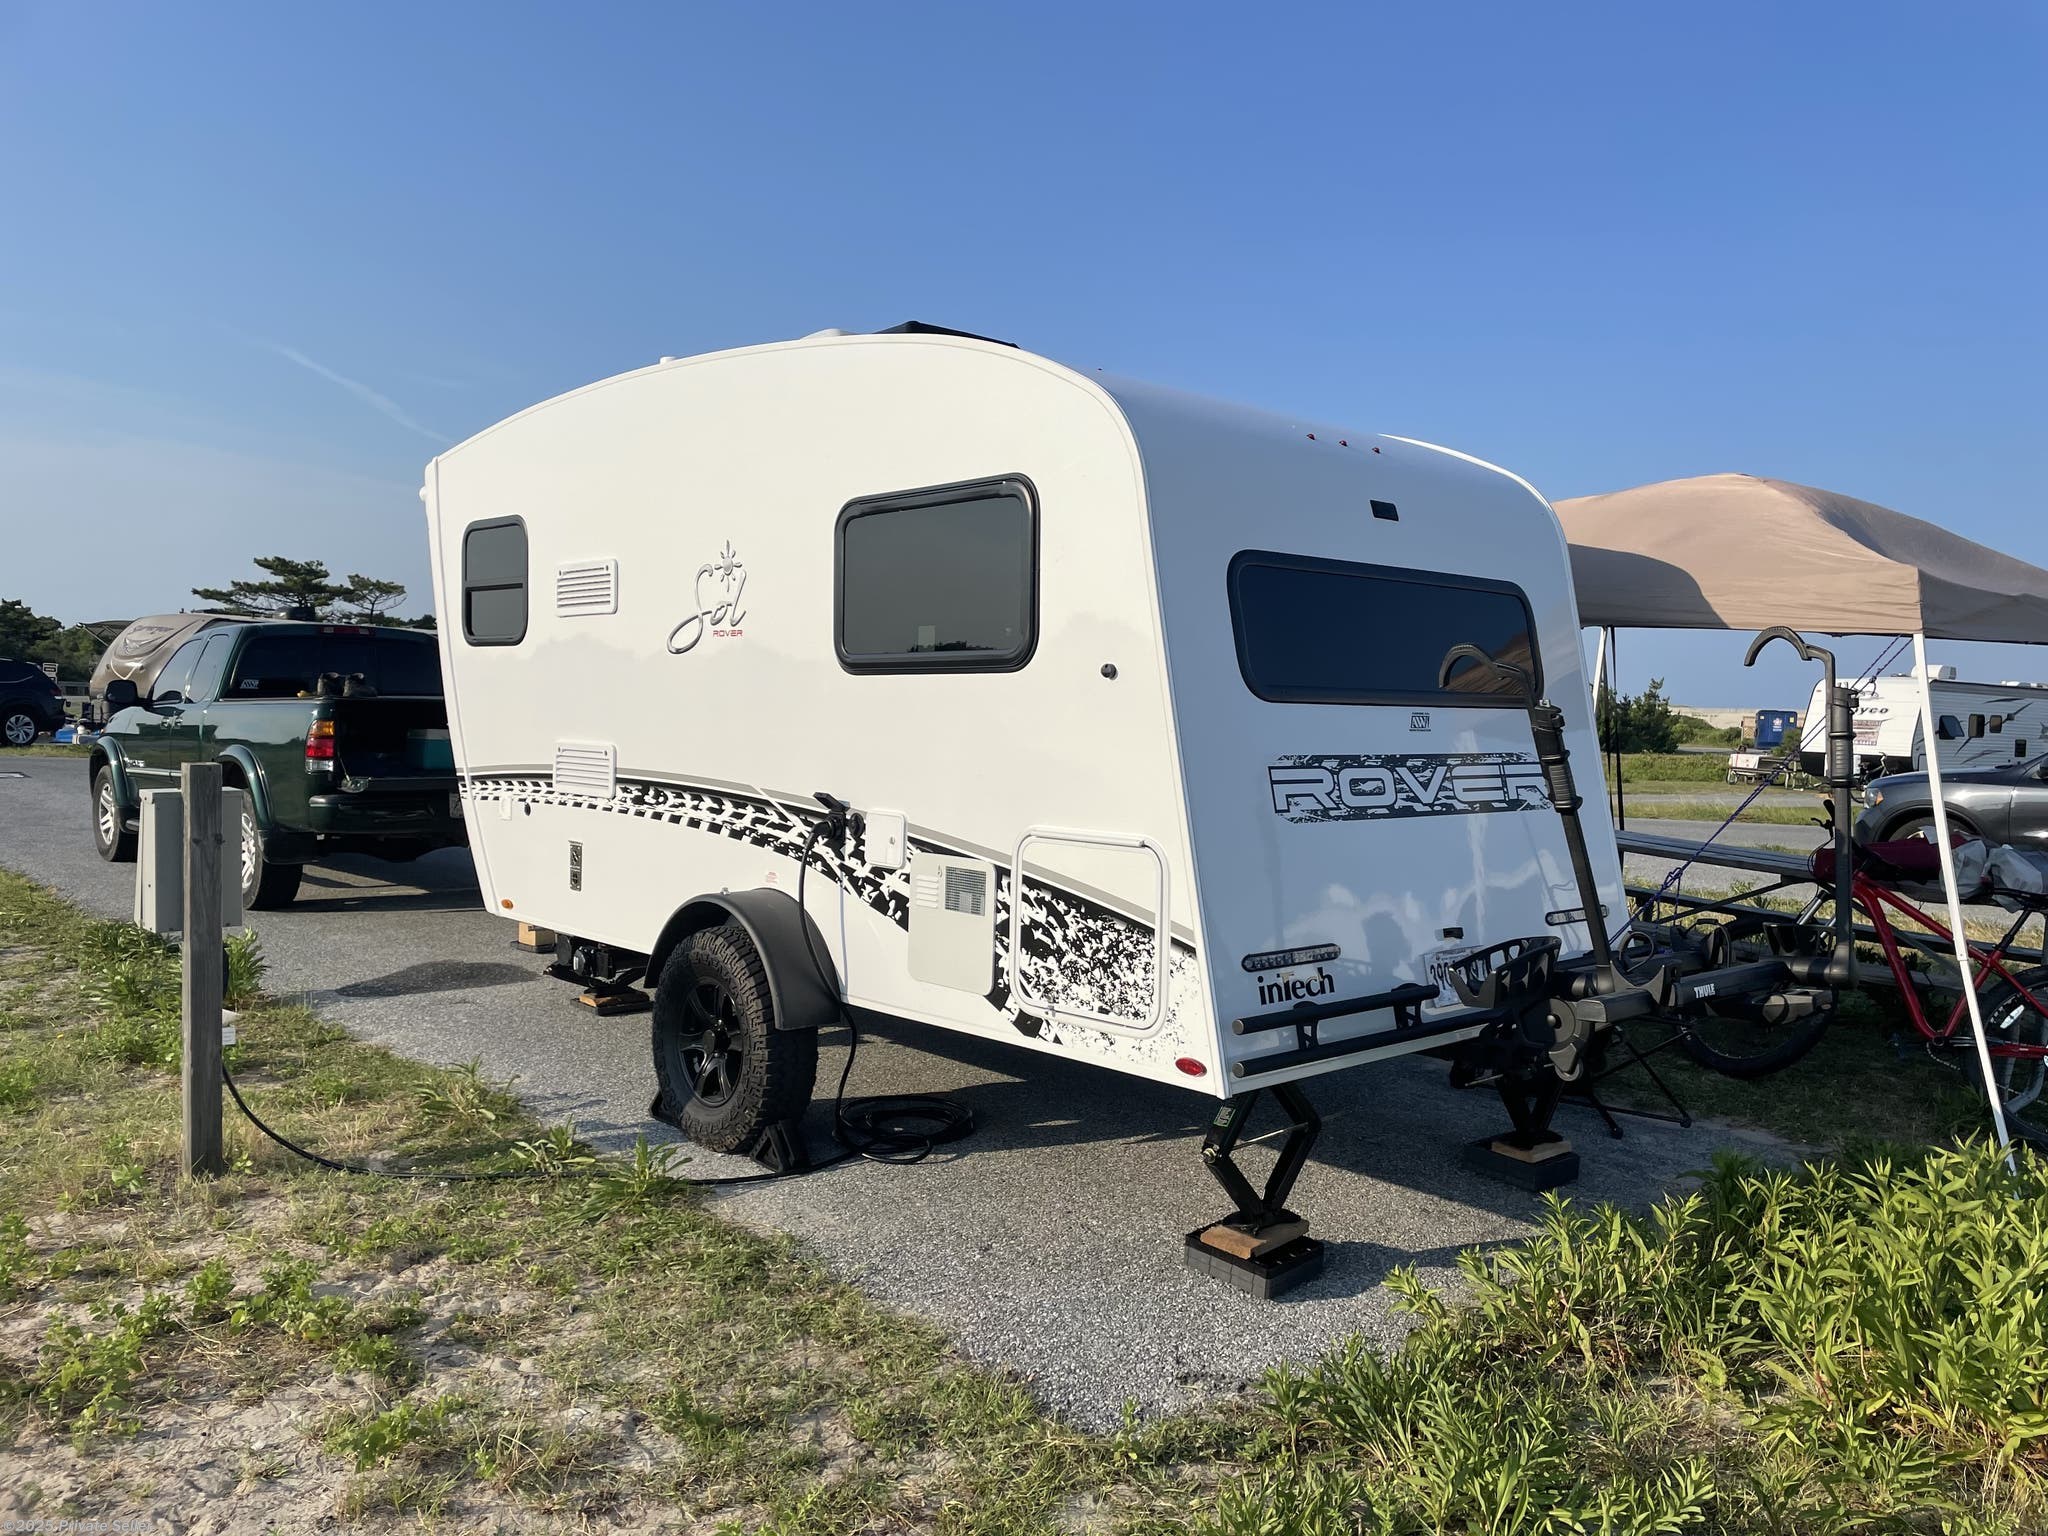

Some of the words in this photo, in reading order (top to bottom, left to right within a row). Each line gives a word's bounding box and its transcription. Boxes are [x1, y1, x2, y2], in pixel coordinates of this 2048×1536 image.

[713, 629, 743, 637] ROVER
[1267, 762, 1550, 814] ROVER
[1693, 983, 1716, 999] THULE
